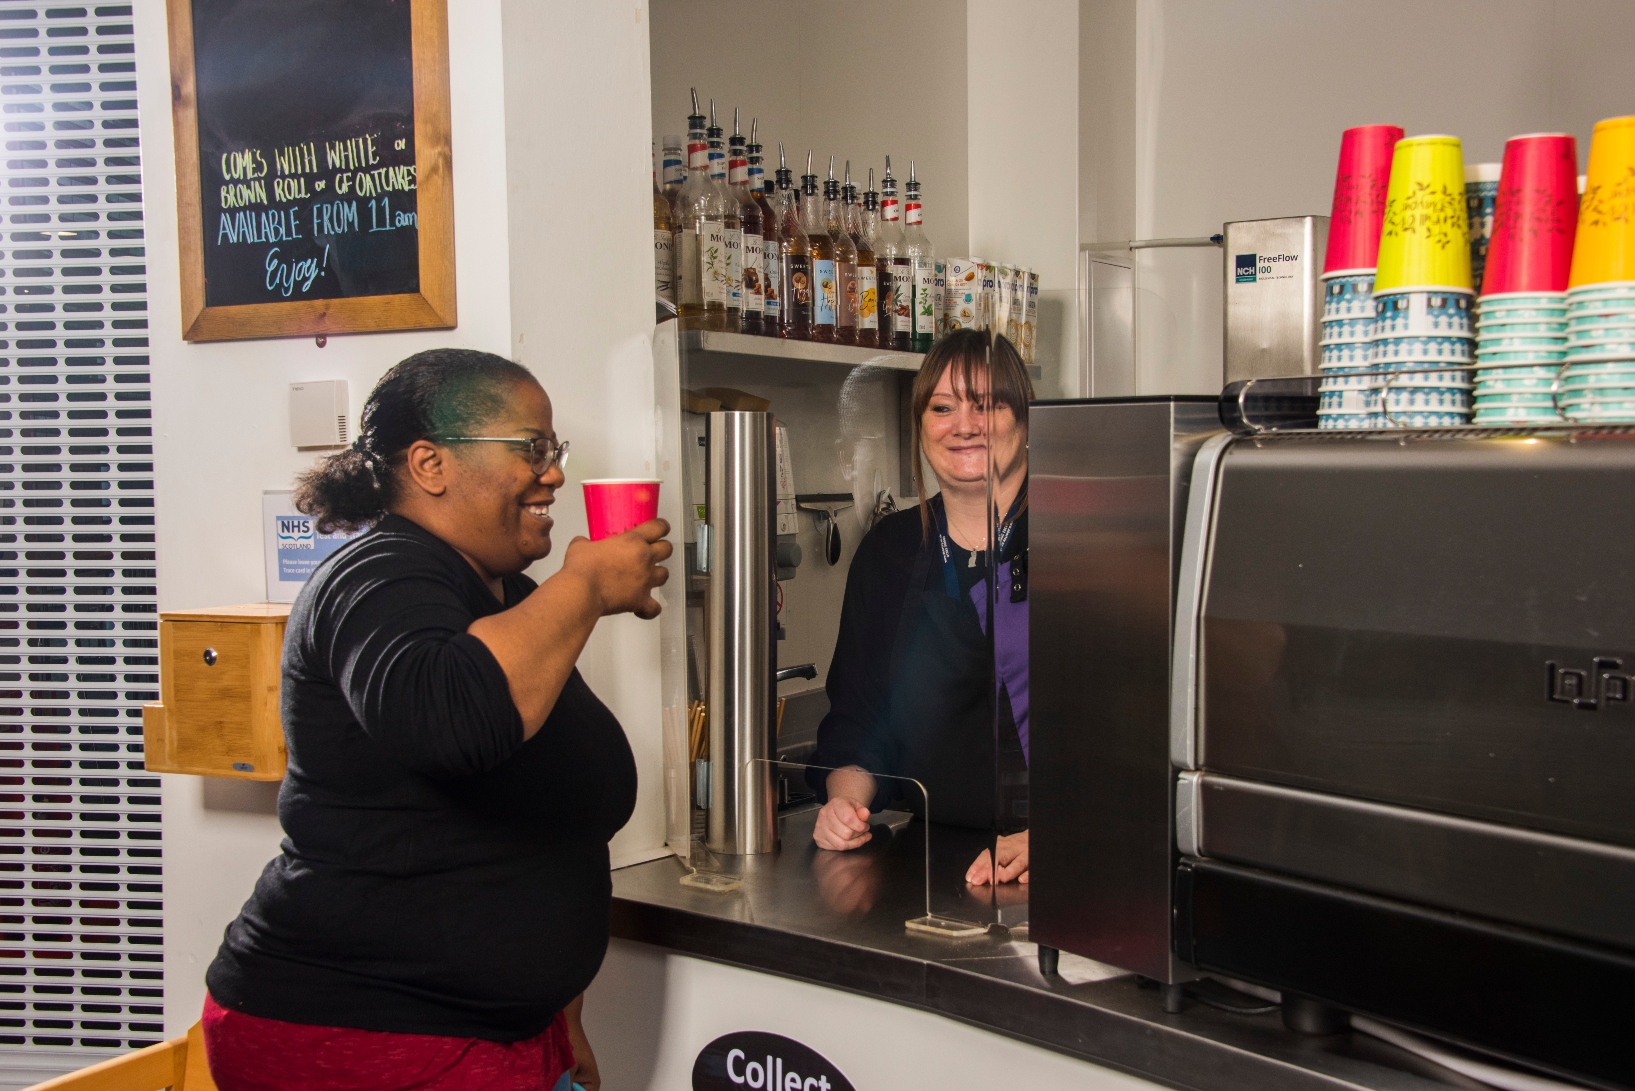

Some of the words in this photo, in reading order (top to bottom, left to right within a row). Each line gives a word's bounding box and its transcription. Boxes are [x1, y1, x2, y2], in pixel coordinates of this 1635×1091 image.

[221, 148, 268, 180] COMES
[274, 141, 318, 176] WITH
[325, 133, 380, 170] WHITE
[220, 179, 268, 209] BROWN
[273, 177, 311, 203] ROLL
[335, 172, 353, 195] GF
[355, 165, 417, 197] OATCAKES
[217, 206, 302, 246] AVAILABLE
[313, 200, 359, 237] FROM
[264, 243, 331, 297] Enjoy!
[1236, 266, 1255, 276] NCH
[1258, 253, 1299, 264] FreeFlow
[281, 520, 311, 534] NHS
